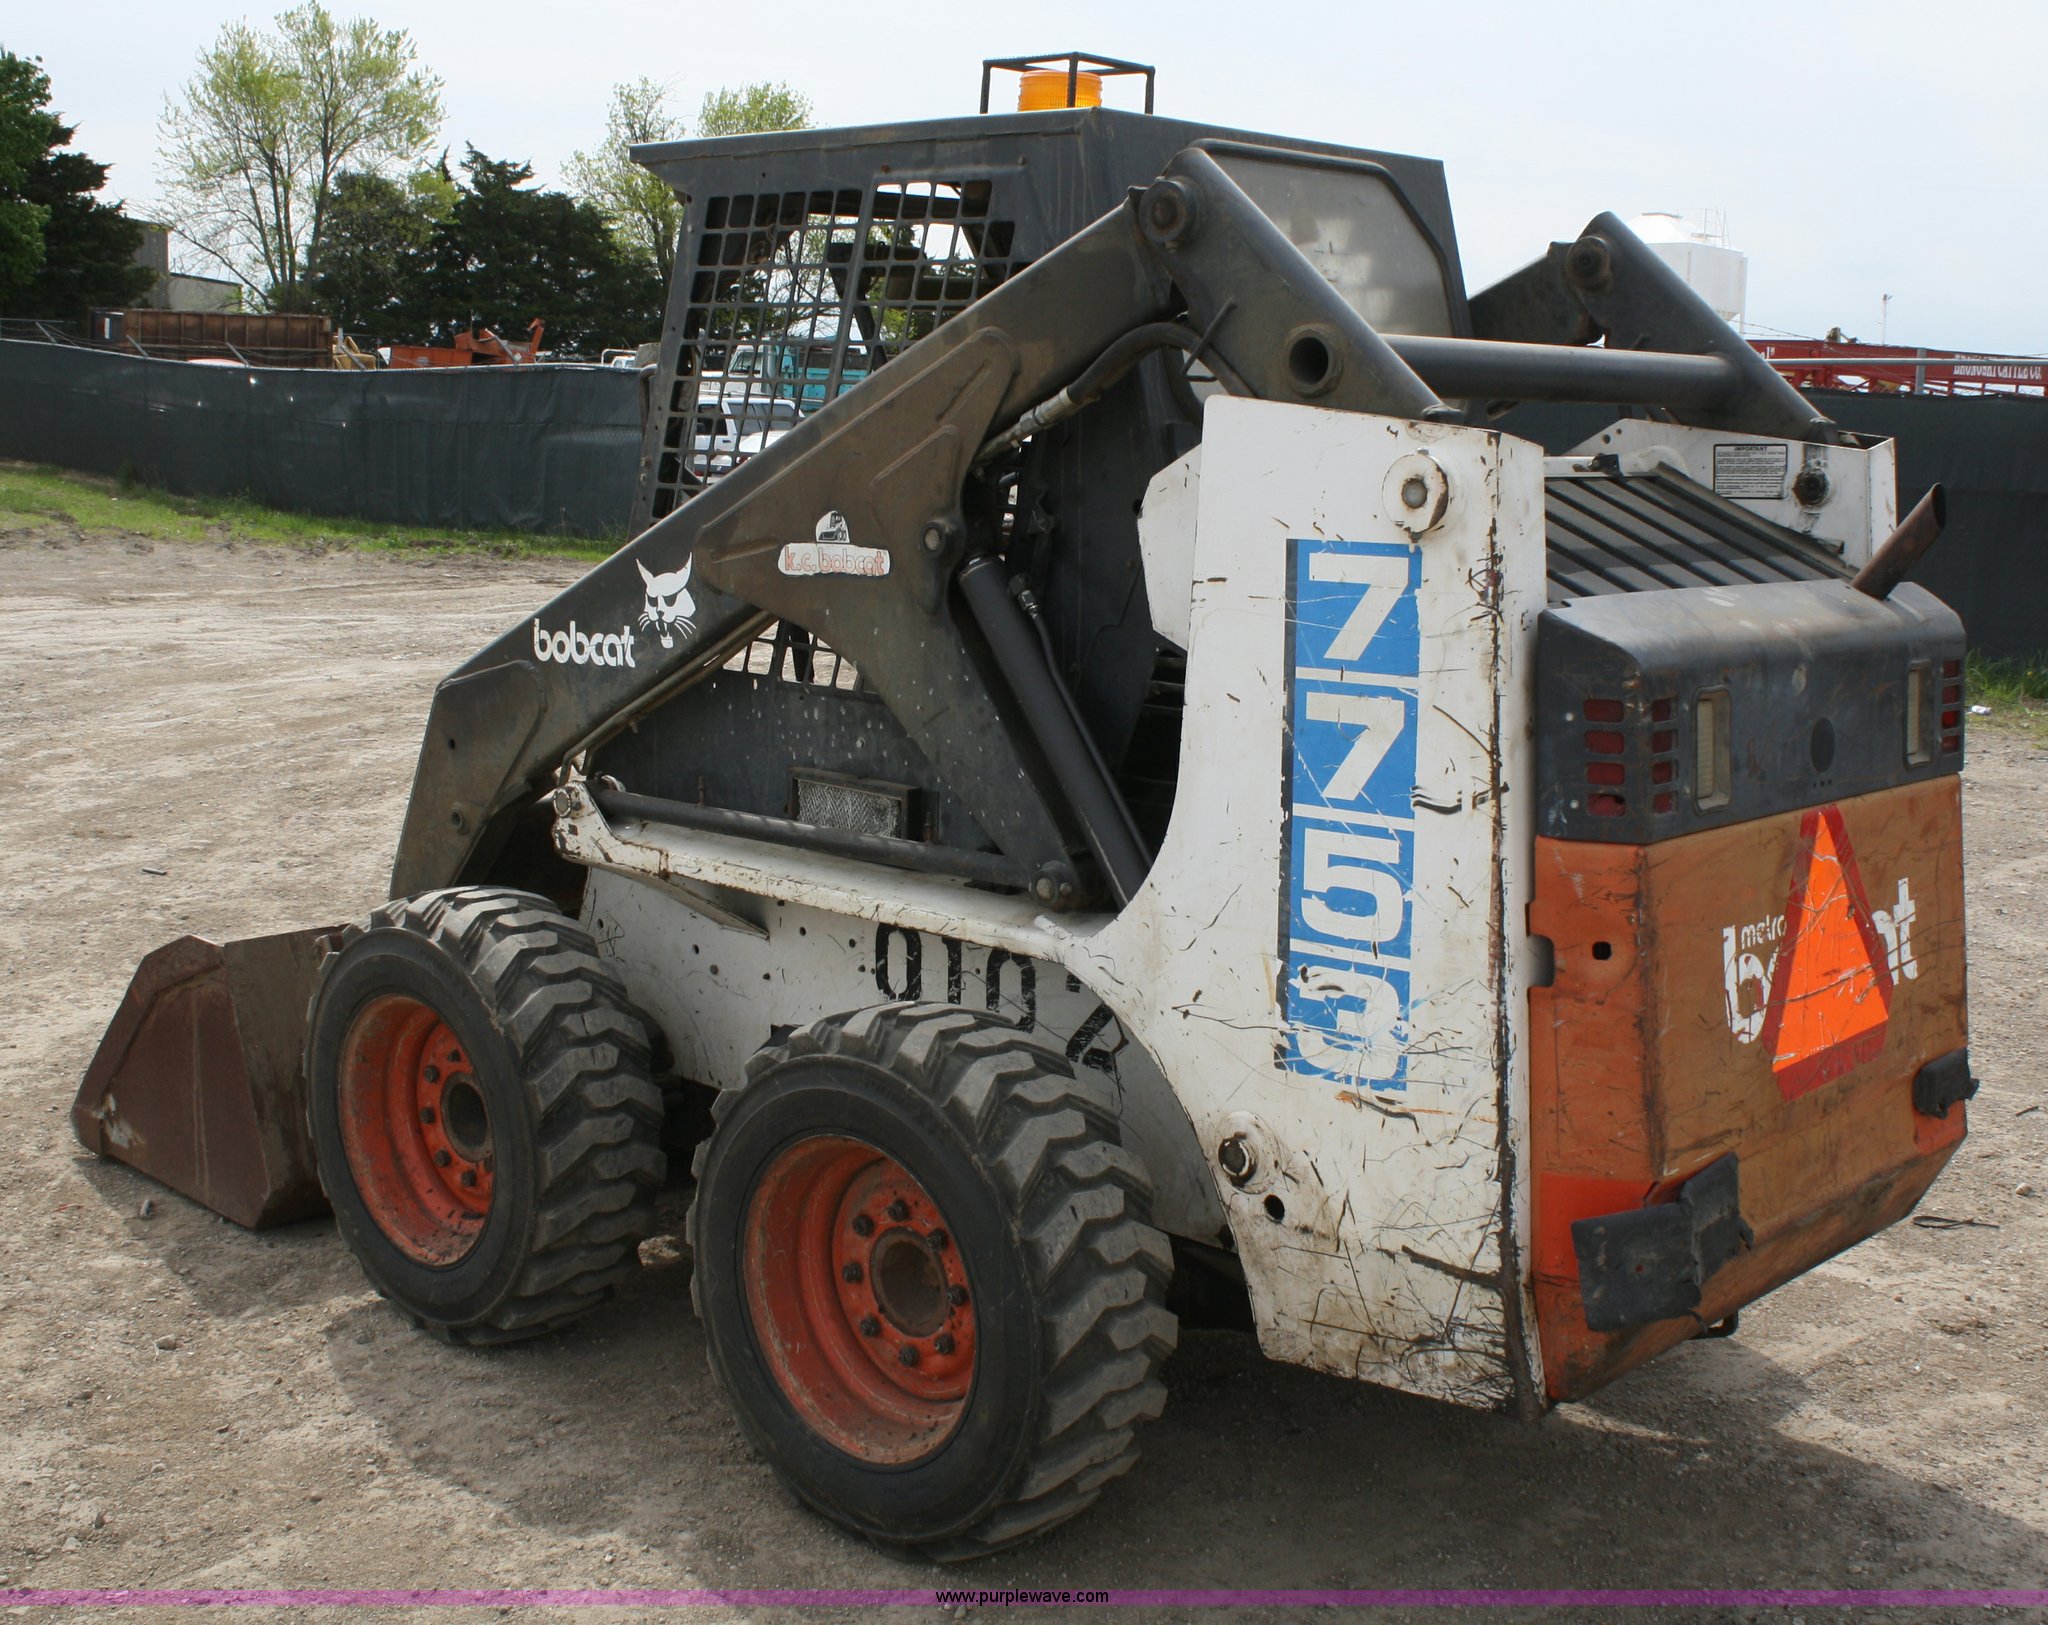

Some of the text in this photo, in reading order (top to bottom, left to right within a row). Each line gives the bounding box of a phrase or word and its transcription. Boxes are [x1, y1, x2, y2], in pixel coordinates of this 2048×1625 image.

[818, 547, 885, 576] bobcat
[533, 618, 636, 668] bobcat
[1297, 553, 1410, 1082] 7753
